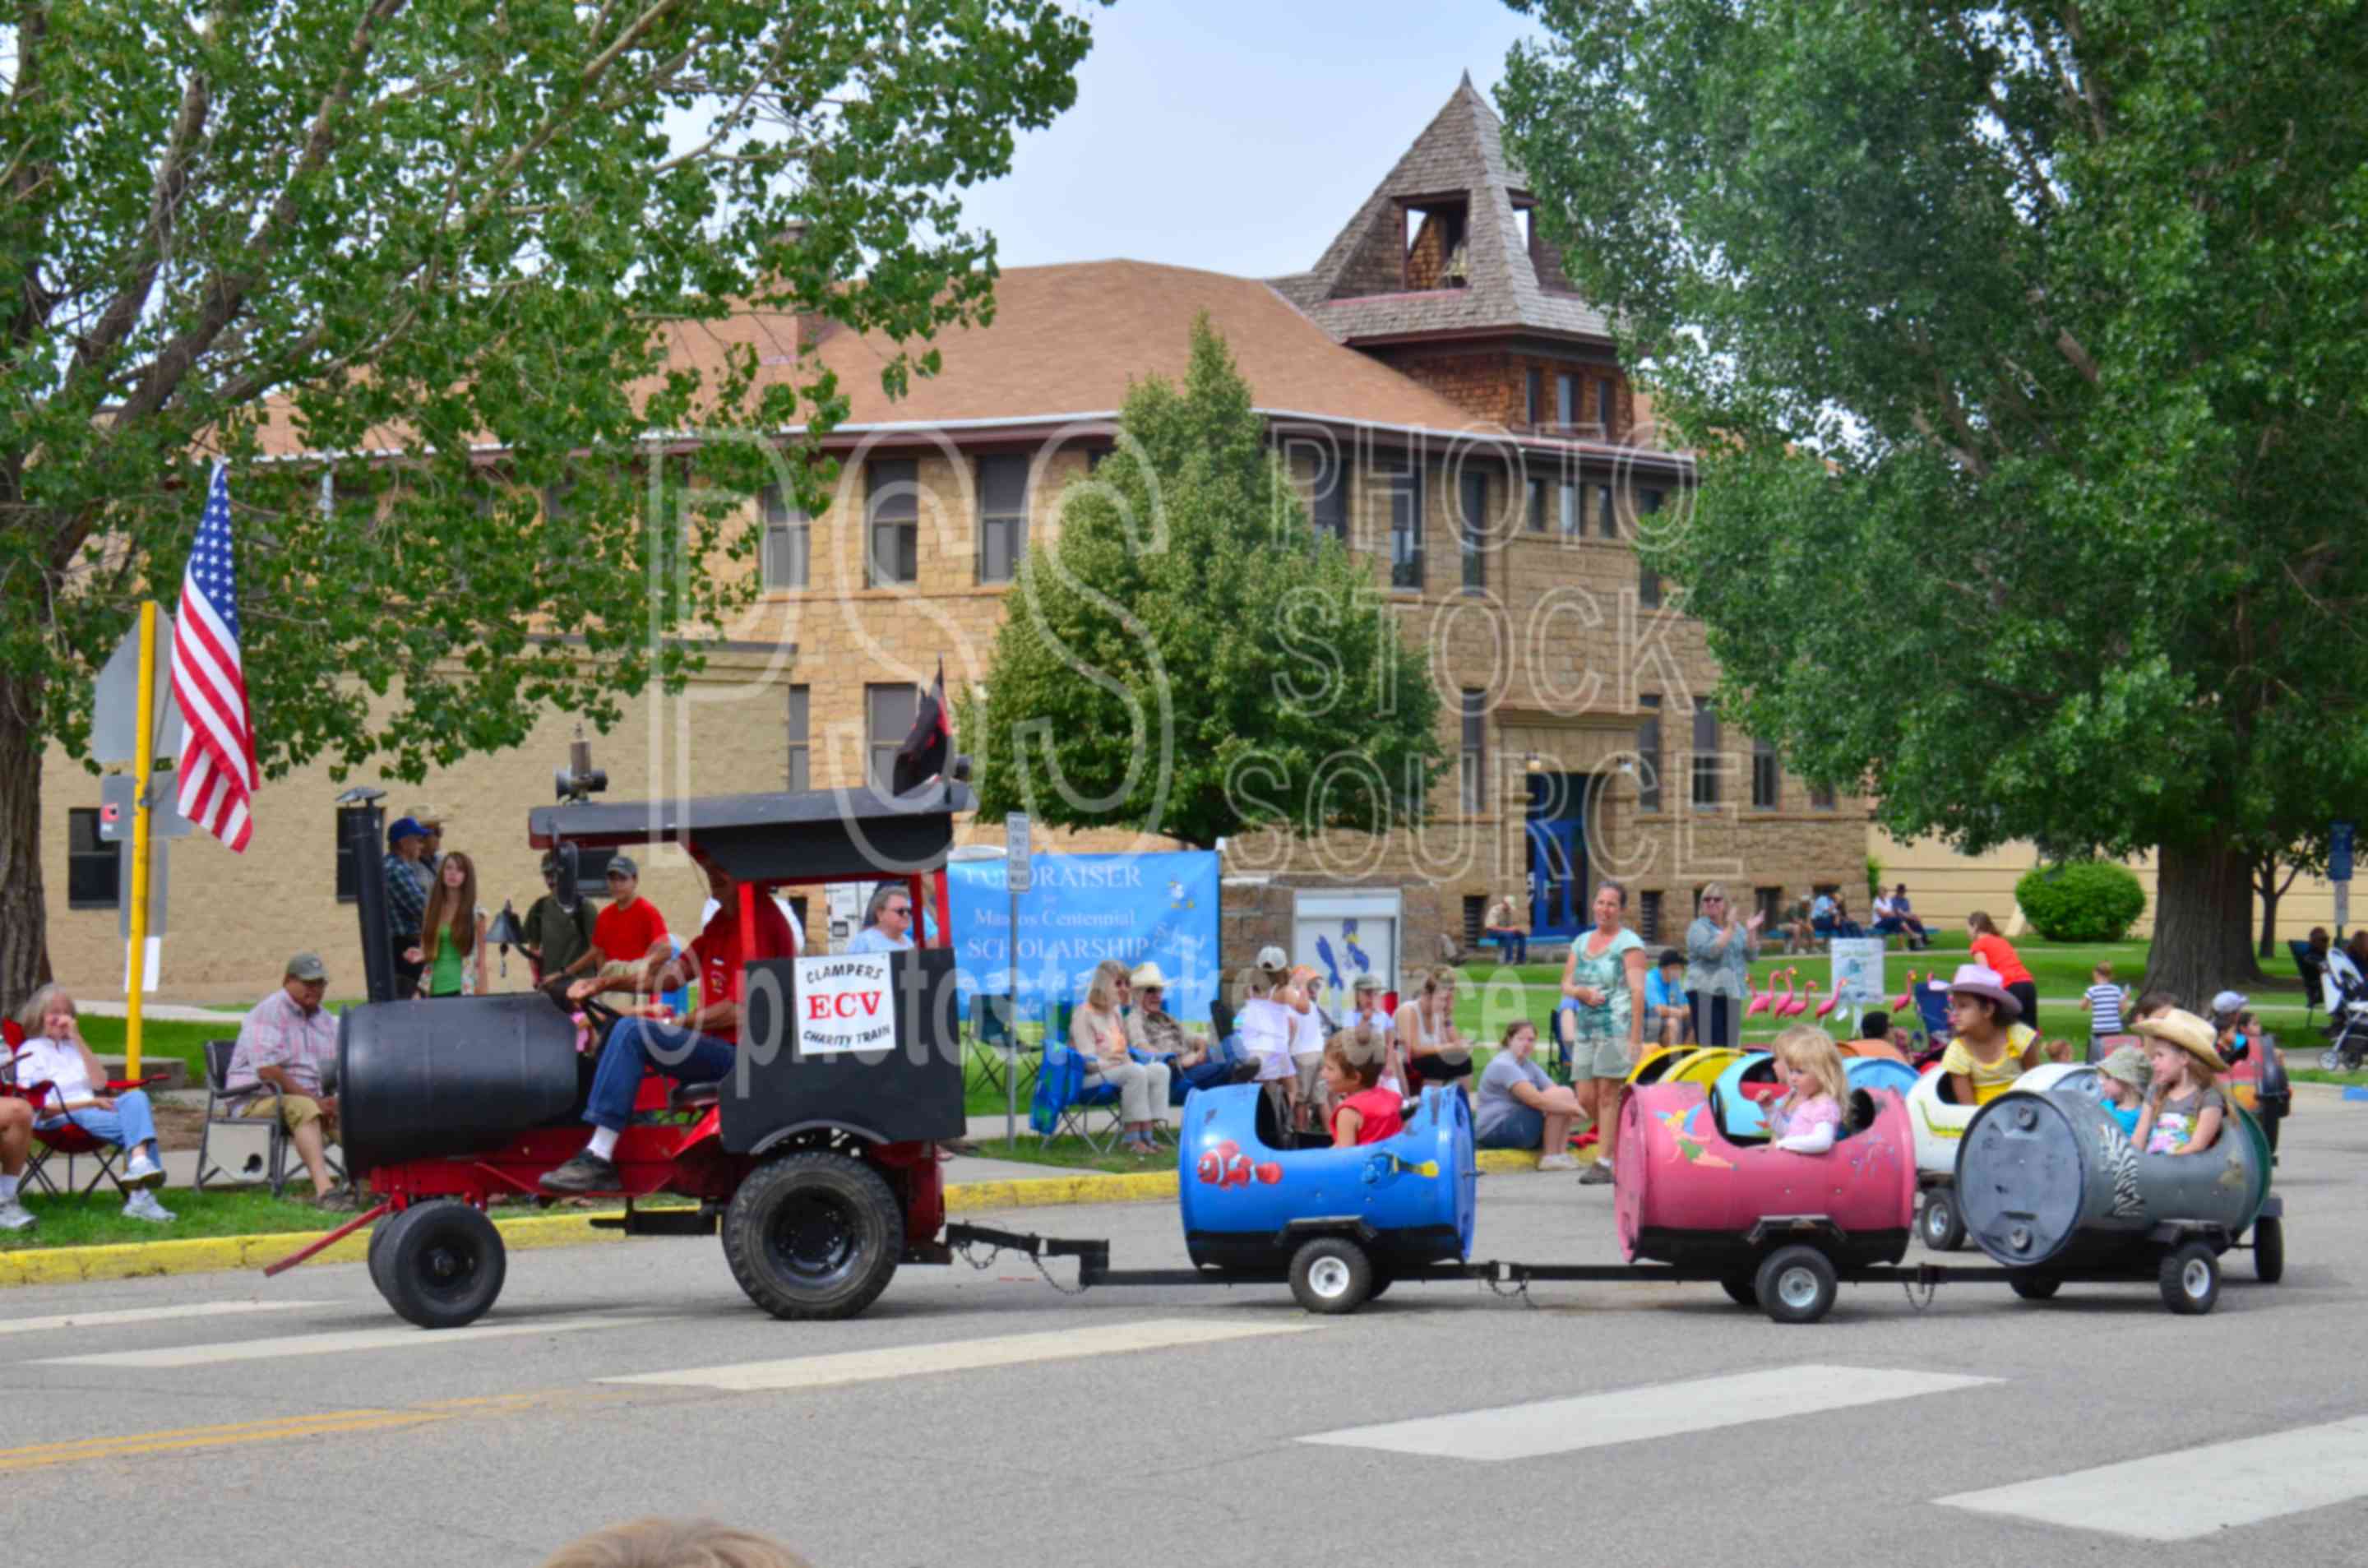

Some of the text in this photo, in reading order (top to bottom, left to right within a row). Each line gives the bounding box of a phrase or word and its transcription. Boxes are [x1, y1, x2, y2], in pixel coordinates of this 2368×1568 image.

[1041, 908, 1135, 928] Centennial
[806, 963, 884, 984] CLAMPERS
[806, 990, 882, 1020] ECV
[802, 1024, 890, 1048] CHARITY TRAIN
